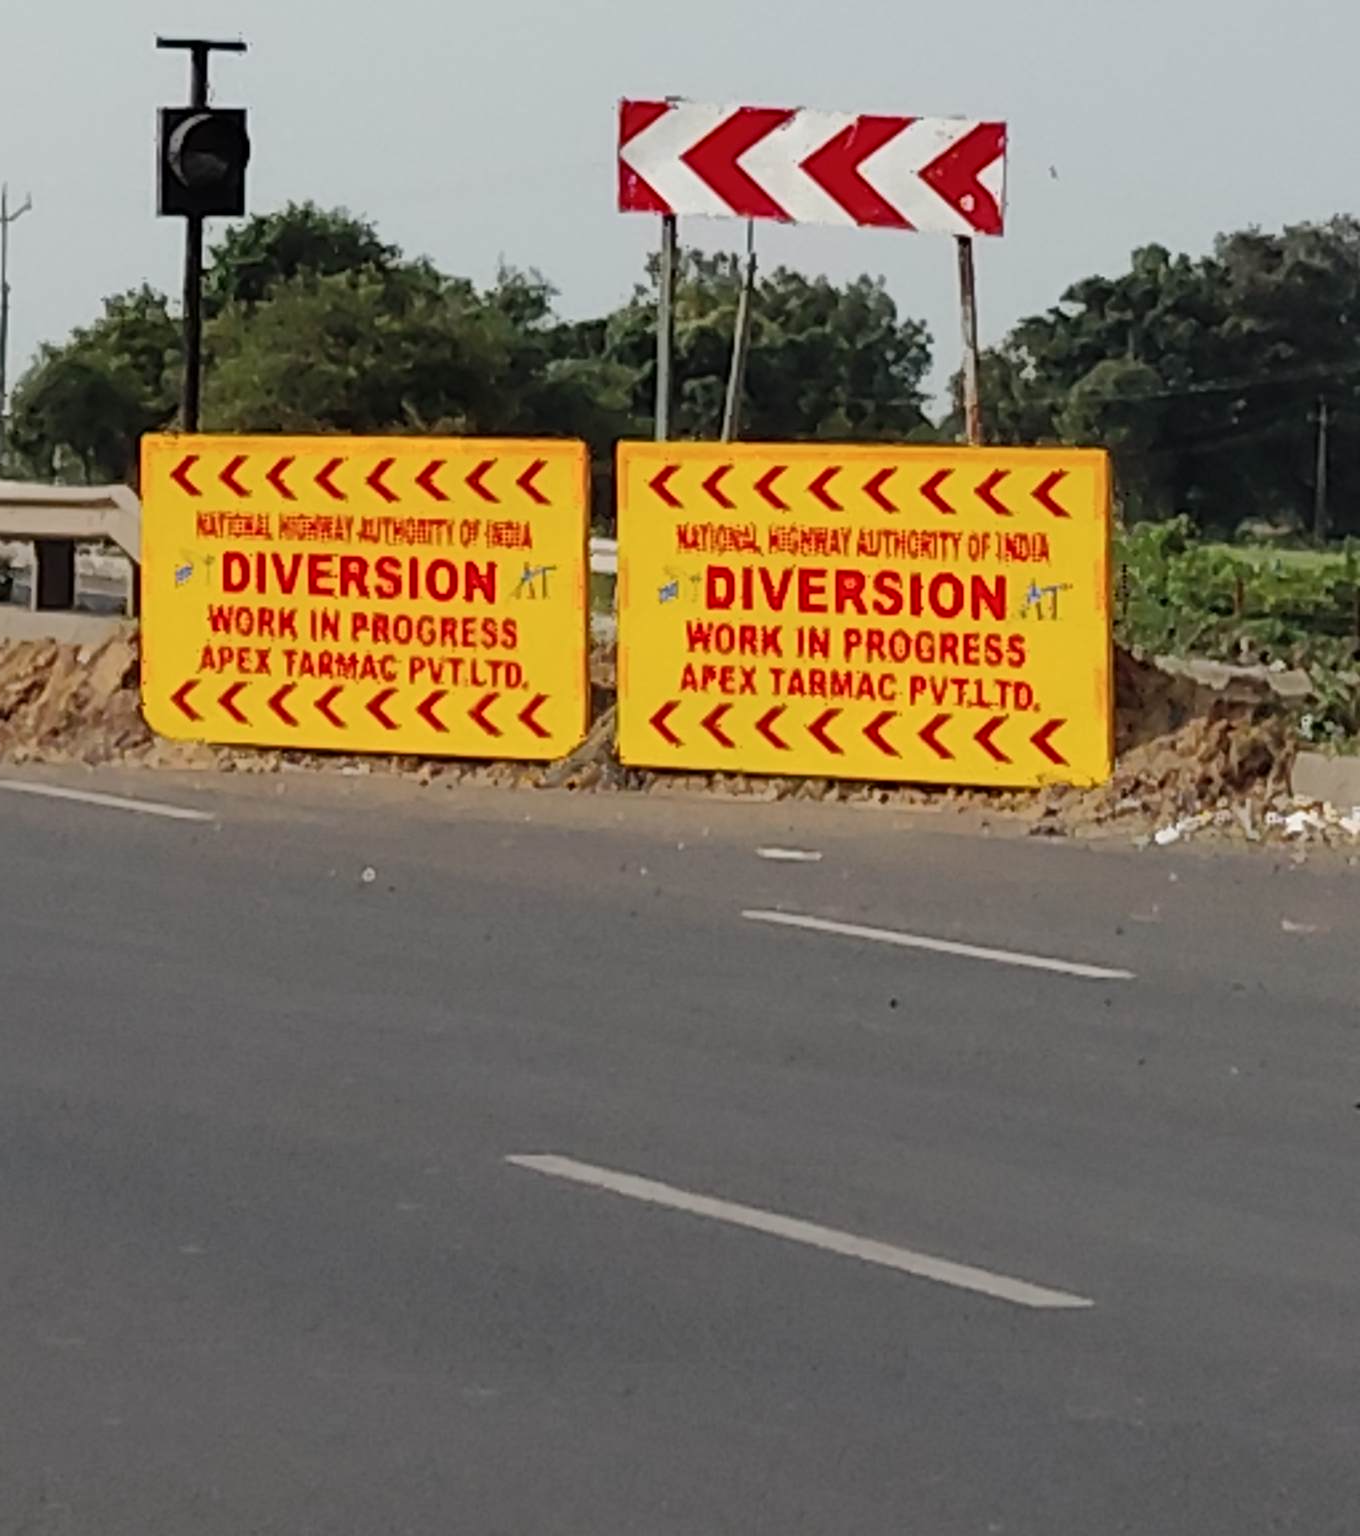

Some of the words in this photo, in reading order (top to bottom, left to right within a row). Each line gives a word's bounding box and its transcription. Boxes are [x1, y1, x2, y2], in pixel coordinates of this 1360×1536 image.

[458, 519, 481, 548] OF
[856, 529, 963, 561] AUTHORITY
[967, 531, 991, 561] OF
[995, 533, 1050, 563] INDIA
[221, 550, 497, 605] DIVERSION
[704, 563, 1008, 621] DIVERSION
[208, 604, 299, 642] WORK
[309, 608, 340, 643] IN
[351, 613, 519, 651] PROGRESS
[684, 620, 784, 659] WORK
[795, 625, 832, 661] IN
[842, 625, 1027, 668] PROGRESS
[193, 644, 273, 676] APEX
[281, 647, 399, 685] TARMAC
[679, 662, 758, 696] APEX
[769, 666, 896, 702] TARMAC
